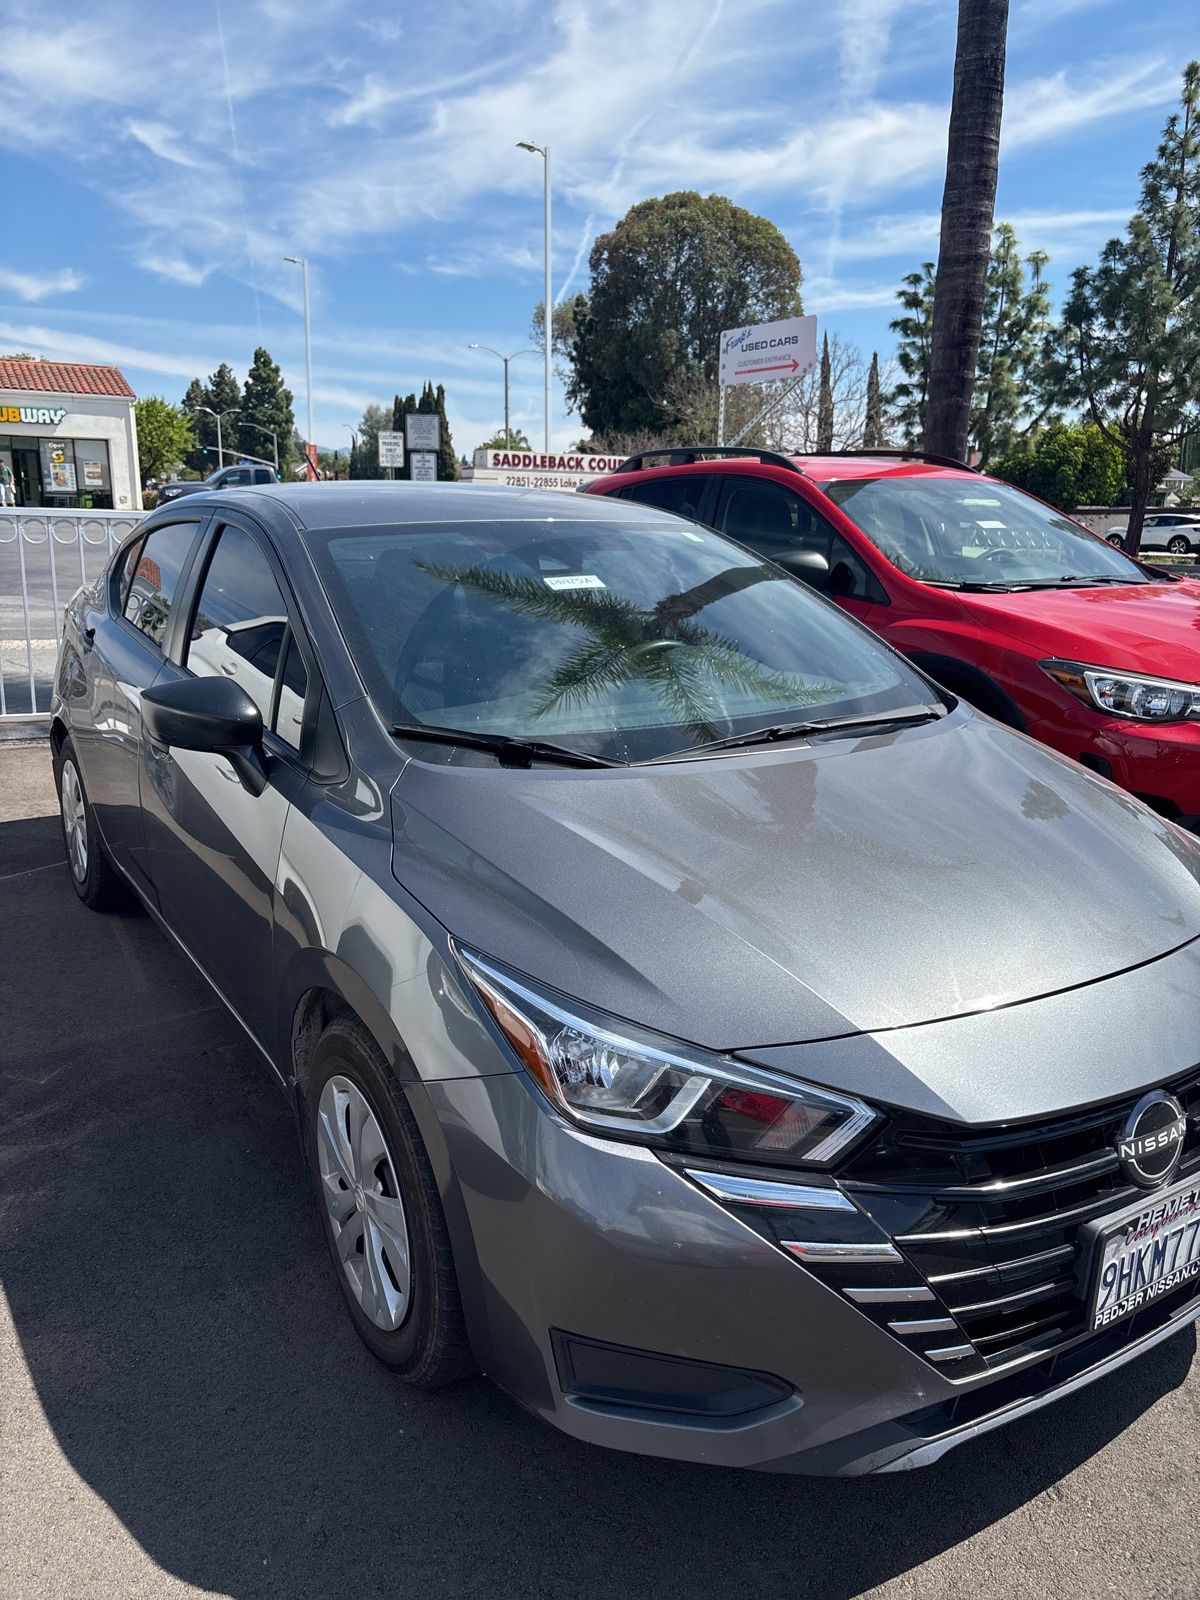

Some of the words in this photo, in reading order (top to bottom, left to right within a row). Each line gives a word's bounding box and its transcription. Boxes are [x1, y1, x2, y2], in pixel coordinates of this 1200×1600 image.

[741, 341, 768, 352] USED
[769, 336, 799, 348] CARS
[738, 358, 764, 367] CUSTOMER
[765, 354, 792, 363] ENTRANCE
[493, 453, 585, 470] SADDLEBACK
[506, 477, 559, 488] 22851-22855
[560, 478, 577, 488] Lake
[1120, 1118, 1187, 1158] NISSAN
[1099, 1217, 1200, 1311] 9HKM77
